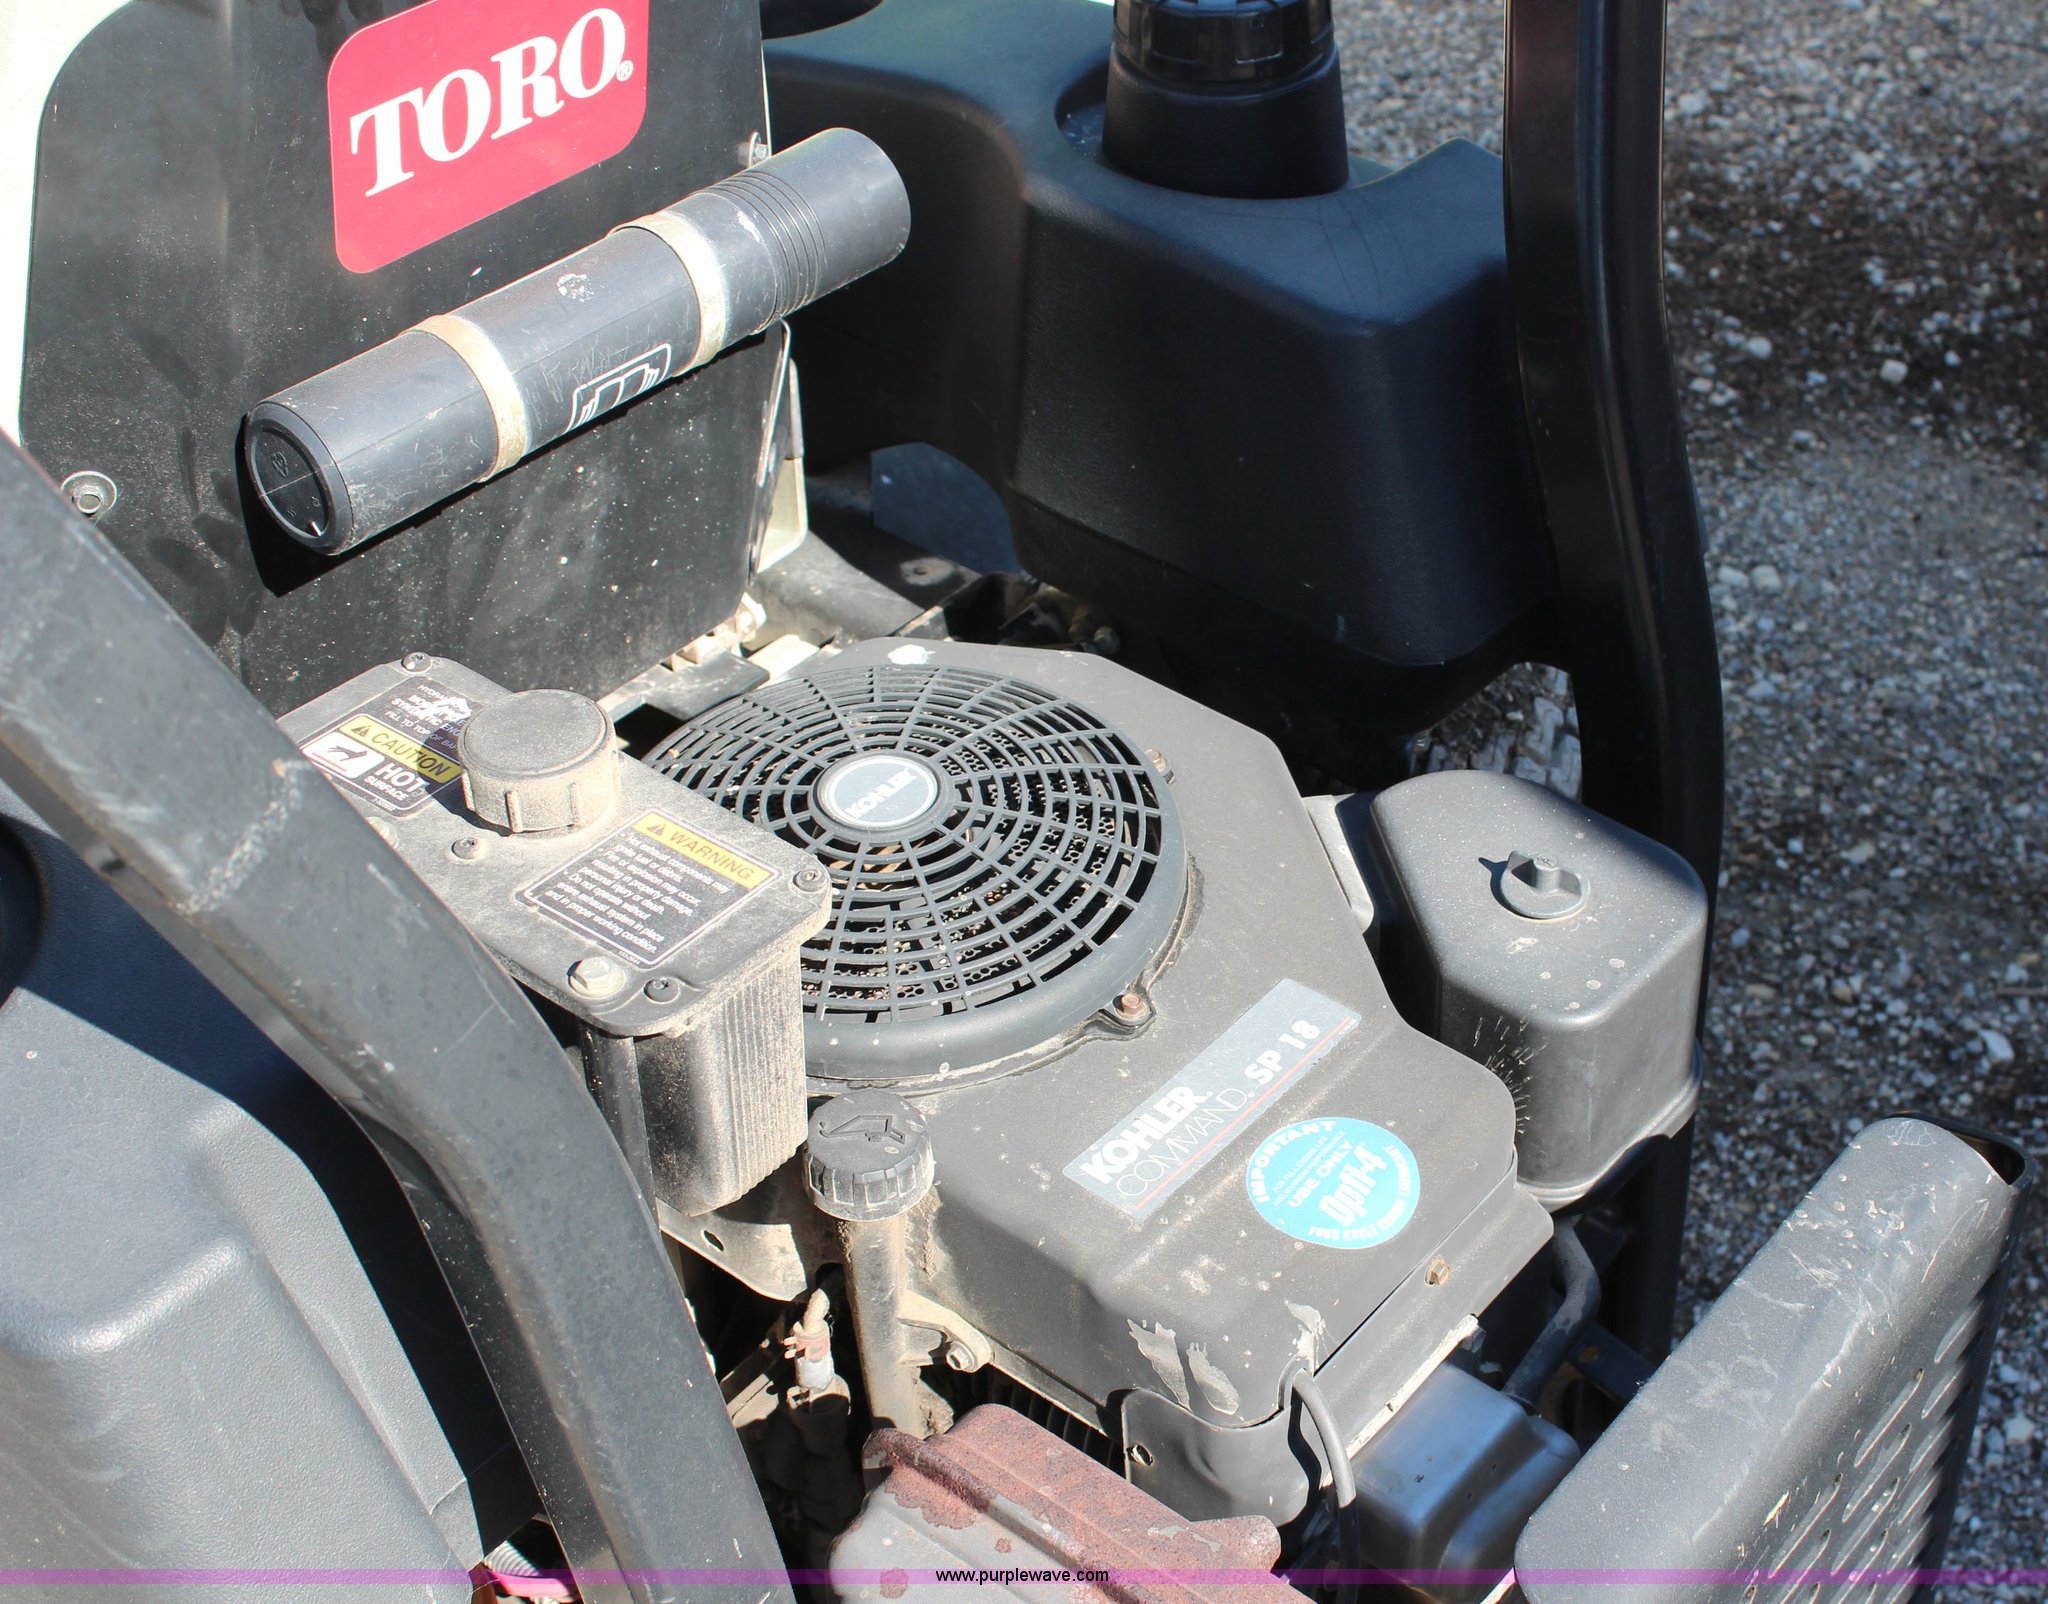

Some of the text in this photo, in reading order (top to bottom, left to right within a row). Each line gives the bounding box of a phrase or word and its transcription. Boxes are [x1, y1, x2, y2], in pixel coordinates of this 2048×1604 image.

[349, 7, 627, 198] TORO
[401, 718, 414, 728] TO
[412, 724, 431, 736] TOP
[371, 732, 451, 777] CAUTION
[363, 775, 409, 801] SURFACE
[374, 762, 431, 793] HOT
[633, 853, 653, 865] fuel
[670, 831, 755, 881] WARNING
[567, 873, 584, 883] Do
[579, 879, 596, 890] not
[589, 886, 624, 906] operate
[576, 865, 615, 887] personal
[607, 882, 636, 898] injury
[630, 894, 644, 902] or
[616, 859, 629, 867] or
[623, 863, 665, 886] explosion
[657, 882, 680, 895] may
[620, 874, 634, 882] in
[626, 879, 664, 900] property
[558, 896, 572, 904] in
[564, 901, 596, 919] proper
[589, 913, 626, 935] working
[603, 908, 636, 927] system
[632, 922, 646, 931] in
[638, 927, 666, 943] place
[1245, 1050, 1282, 1084] SP
[1279, 1021, 1320, 1049] 18
[1080, 1087, 1208, 1184] KOHLER
[1117, 1089, 1247, 1195] COMMAND
[1251, 1121, 1336, 1203] IMPORTANT
[1287, 1140, 1352, 1207] USE ONLY
